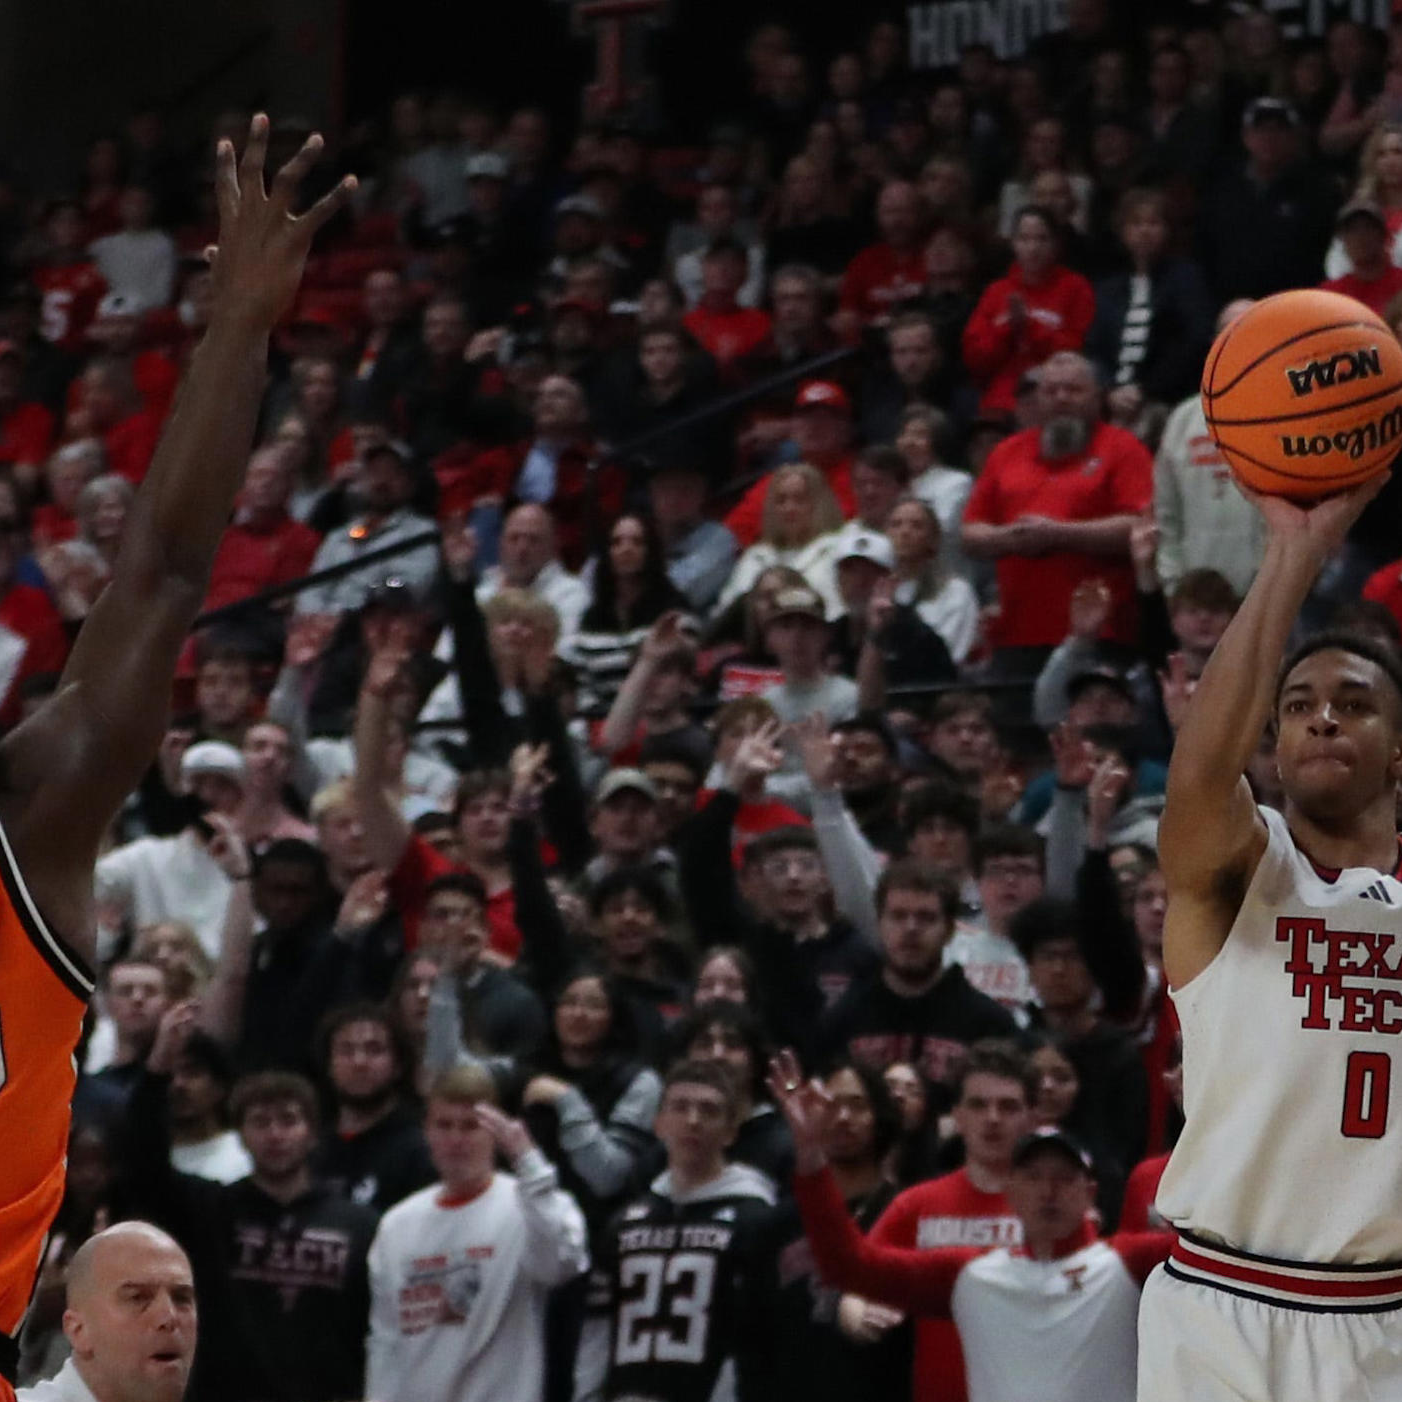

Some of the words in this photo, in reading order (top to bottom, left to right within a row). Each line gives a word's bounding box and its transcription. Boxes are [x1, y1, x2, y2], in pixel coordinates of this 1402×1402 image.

[1286, 346, 1383, 397] NCAA
[1340, 1050, 1391, 1139] 0
[615, 1251, 718, 1366] 23
